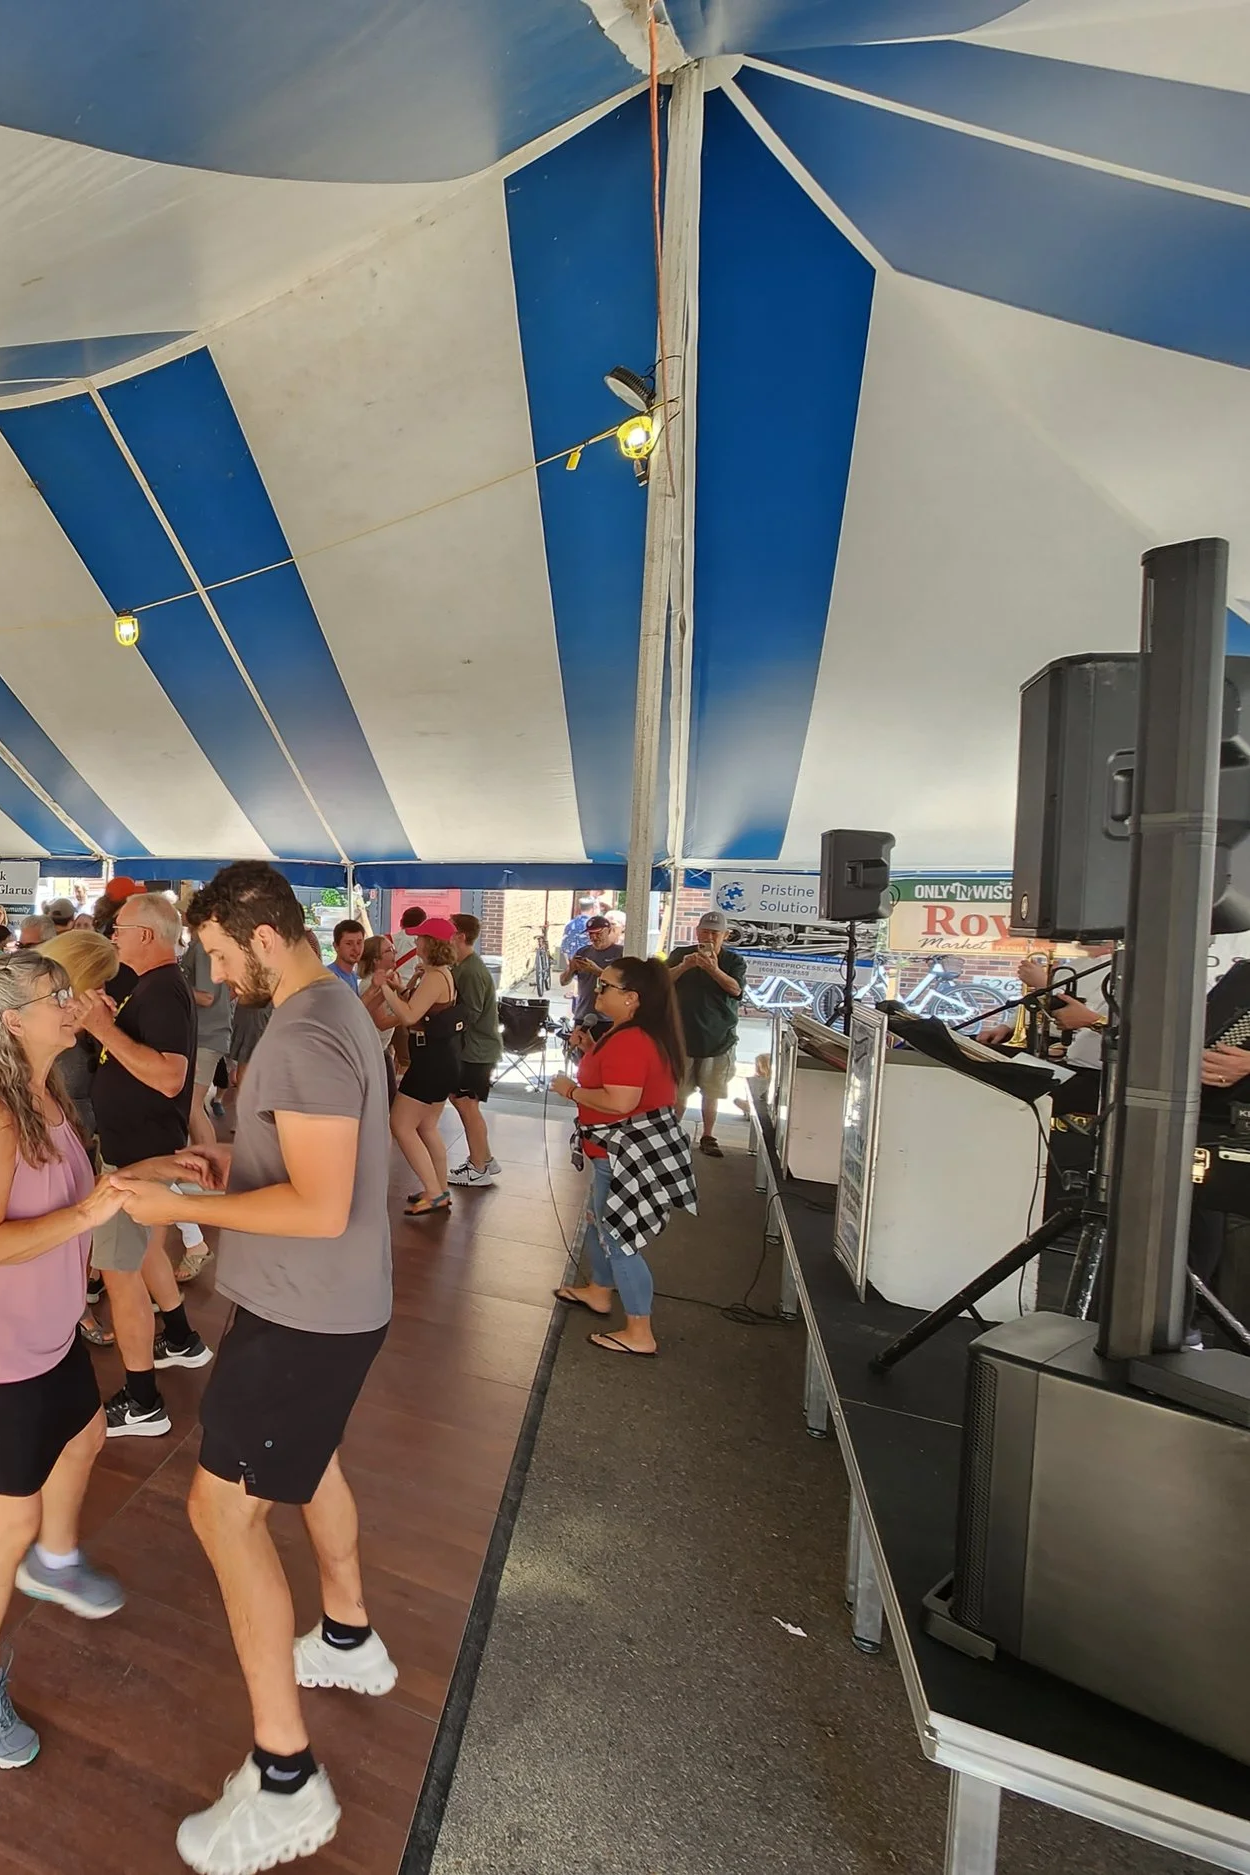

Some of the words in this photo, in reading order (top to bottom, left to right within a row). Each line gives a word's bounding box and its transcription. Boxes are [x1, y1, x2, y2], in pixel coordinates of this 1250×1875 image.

[761, 884, 815, 898] Pristine
[914, 884, 949, 899] ONLY
[917, 936, 995, 952] Market
